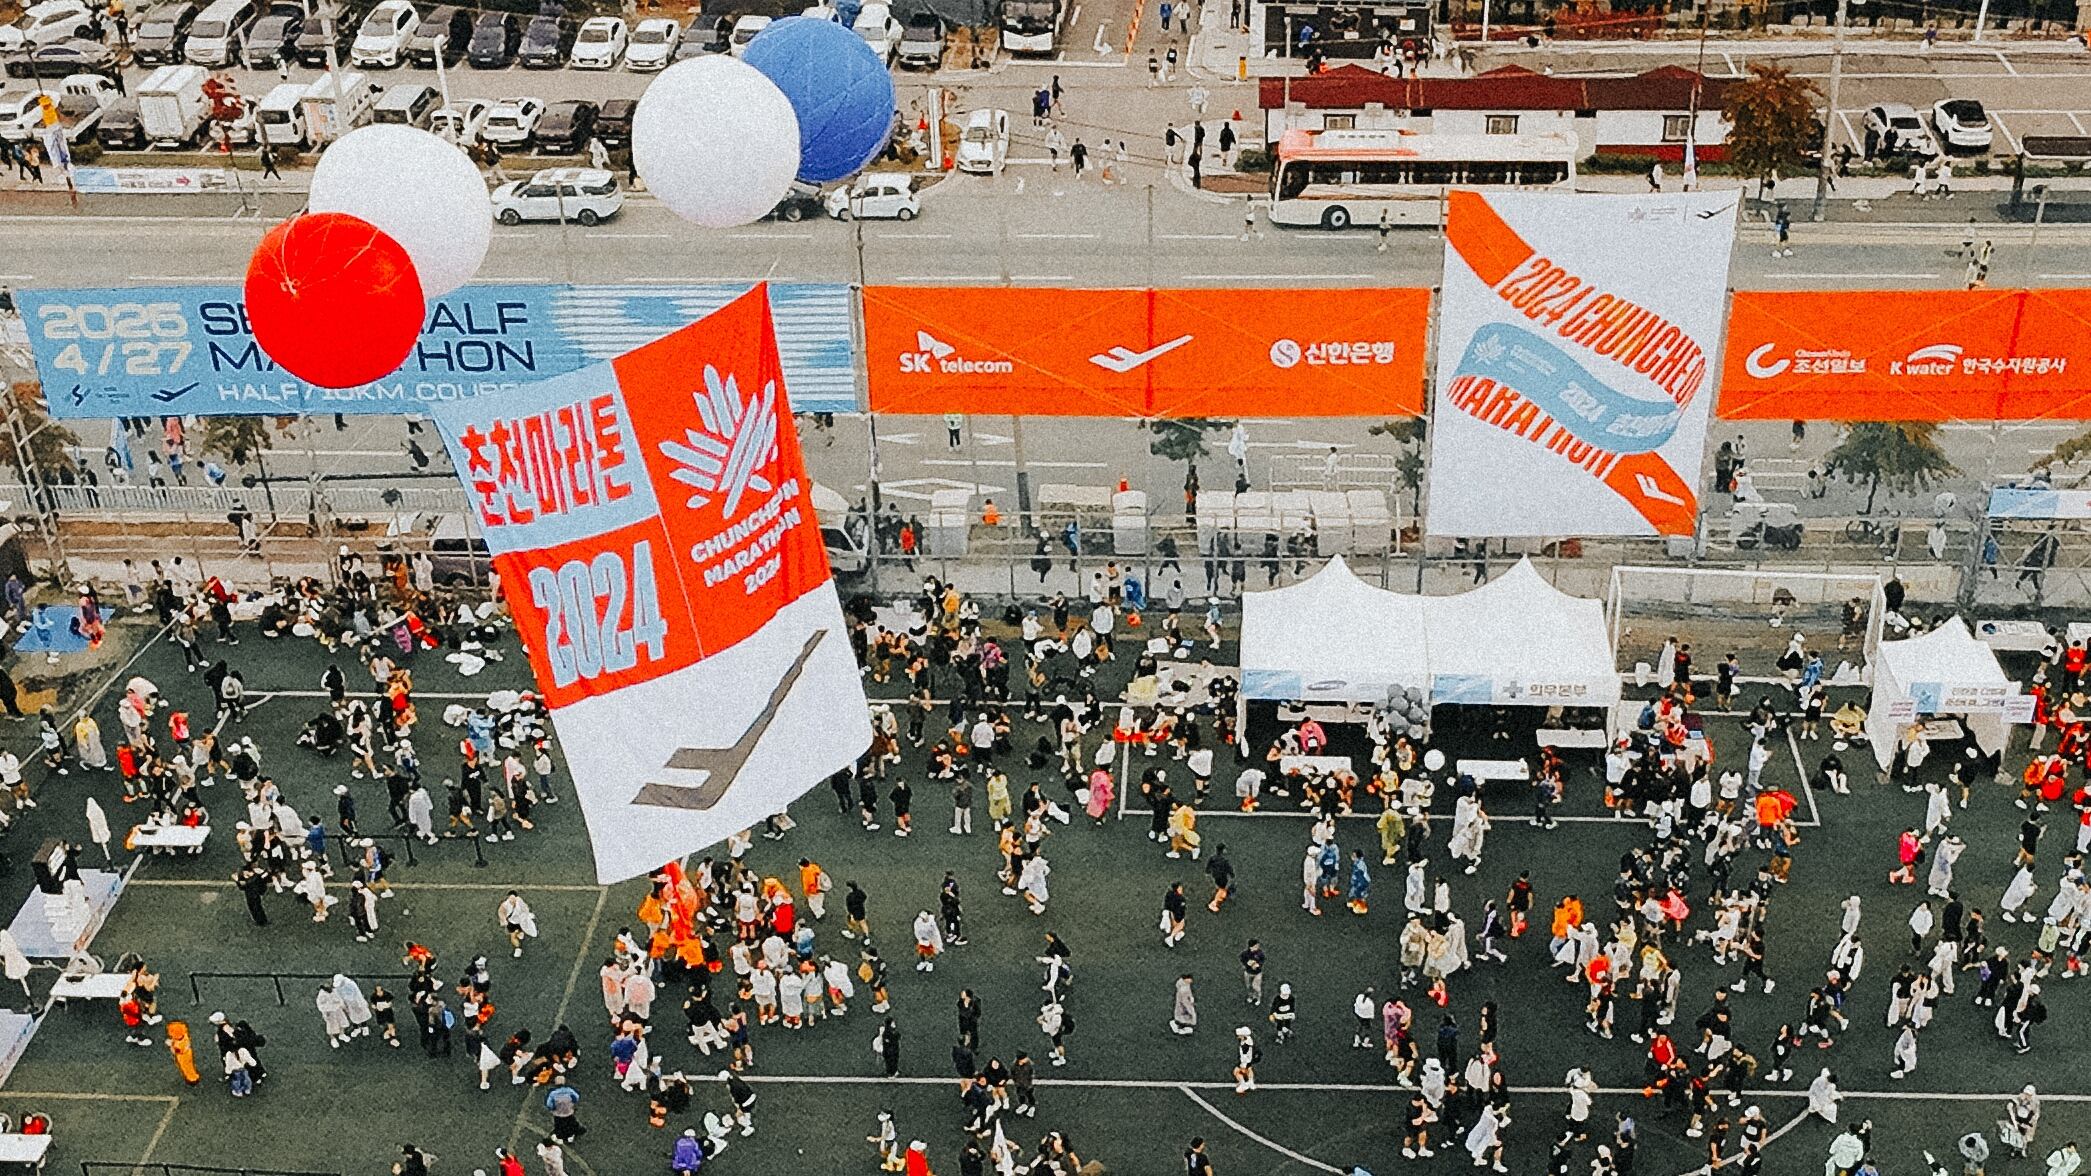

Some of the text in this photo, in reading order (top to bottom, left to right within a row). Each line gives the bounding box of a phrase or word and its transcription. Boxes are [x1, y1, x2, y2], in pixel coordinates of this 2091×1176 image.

[1497, 257, 1596, 327] 2024
[420, 302, 528, 335] ALF
[53, 341, 193, 376] 4/27
[899, 353, 1013, 373] SK telecom
[1304, 341, 1395, 365] 신한은행
[1792, 359, 1866, 373] 조선일보
[1962, 357, 2067, 375] 한국수자원공사
[1906, 362, 1954, 375] water
[459, 393, 633, 527] 춘천마라톤
[528, 539, 669, 690] 2024
